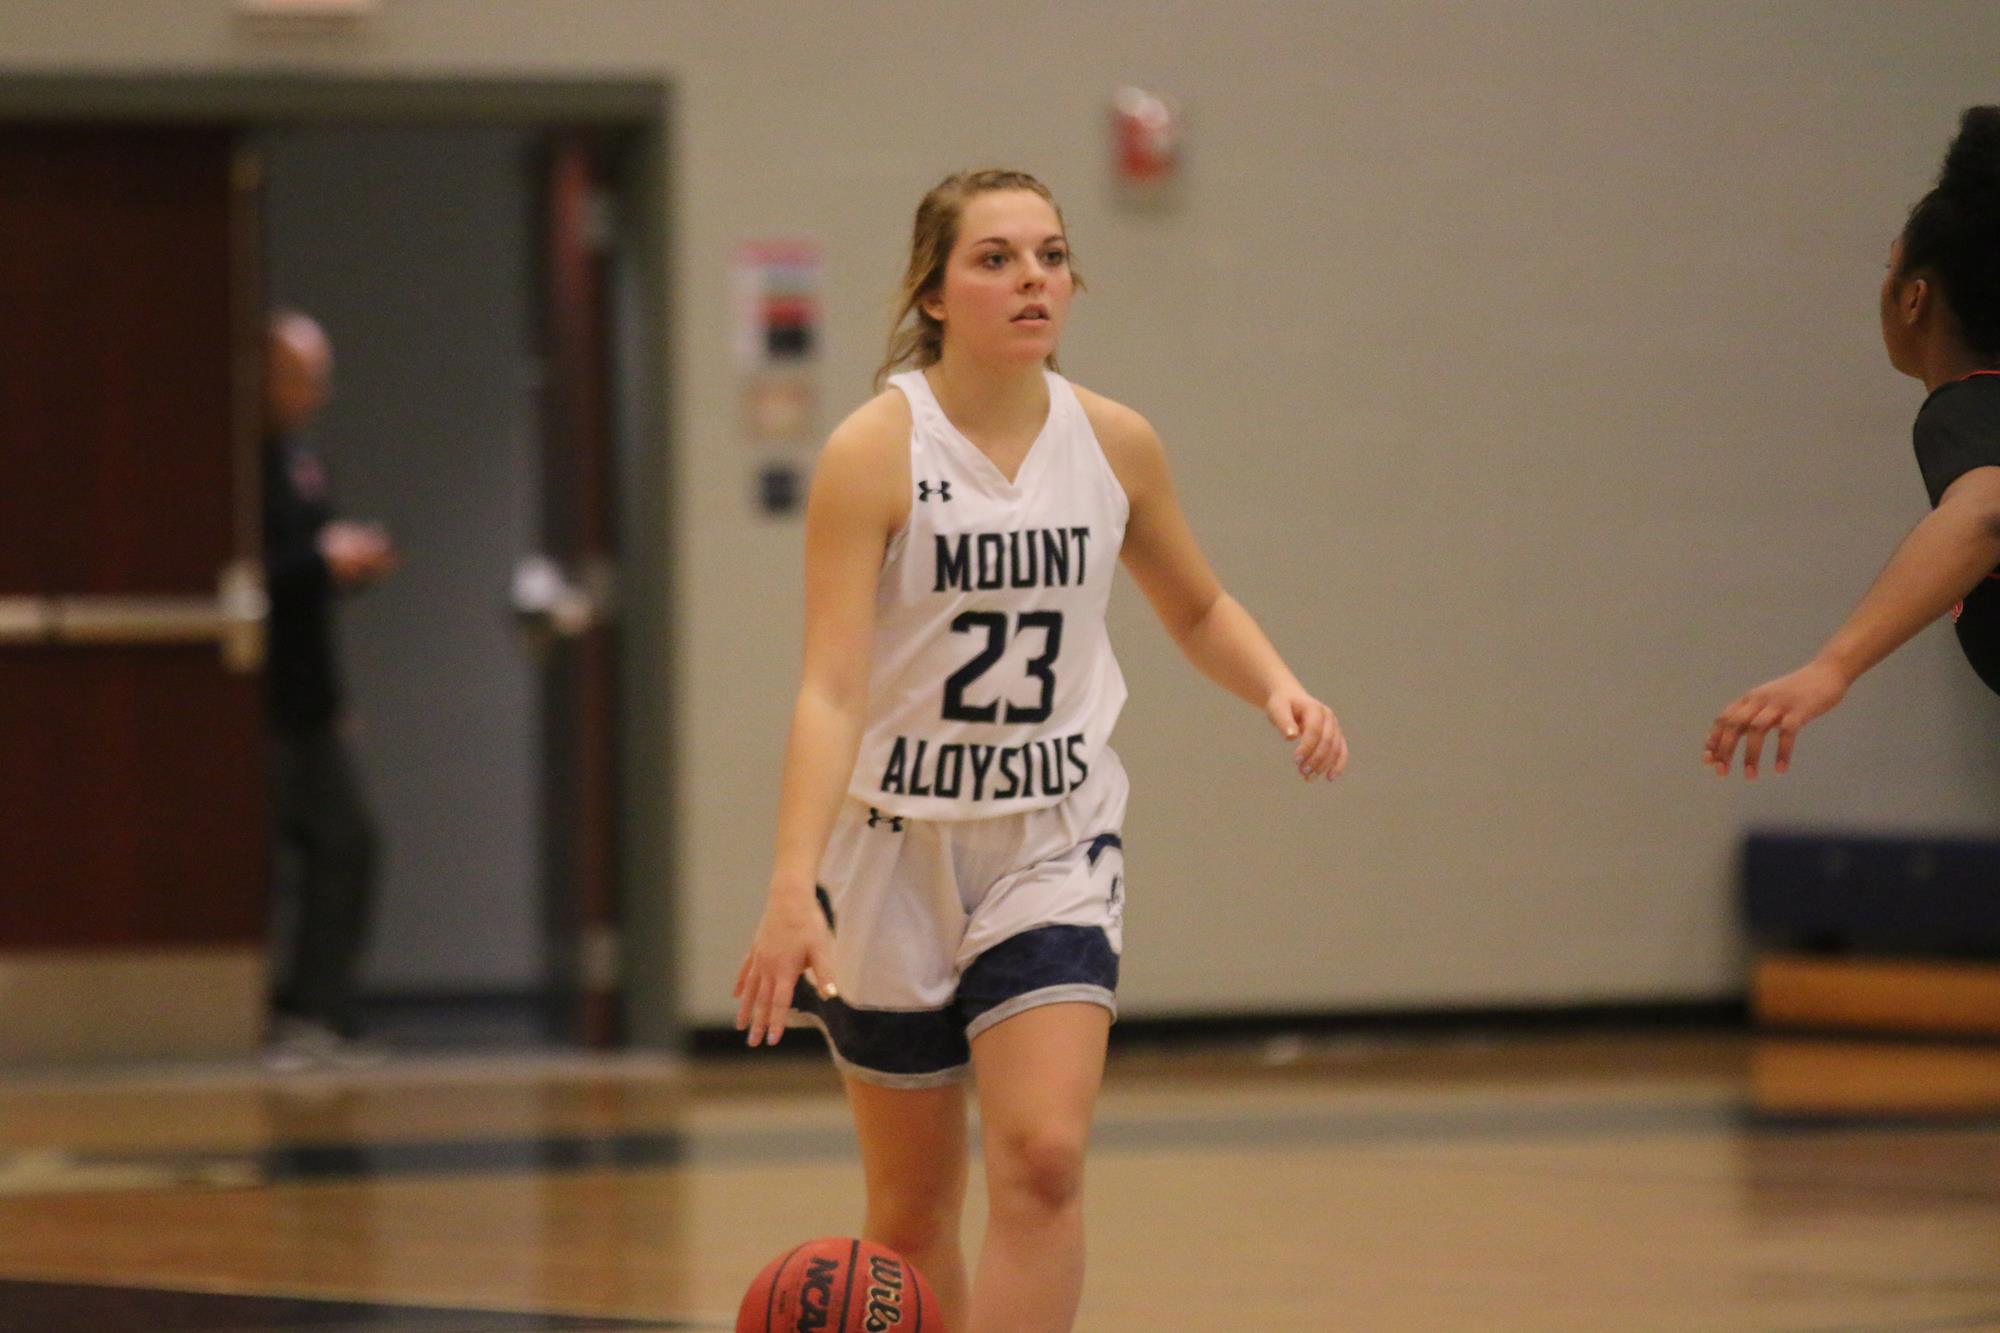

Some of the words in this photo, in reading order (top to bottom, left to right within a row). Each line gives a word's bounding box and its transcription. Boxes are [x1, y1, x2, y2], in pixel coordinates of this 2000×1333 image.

[932, 527, 1090, 592] MOUNT
[941, 610, 1063, 724] 23
[880, 733, 1088, 801] ALOYSIUS
[797, 1256, 839, 1333] NCA
